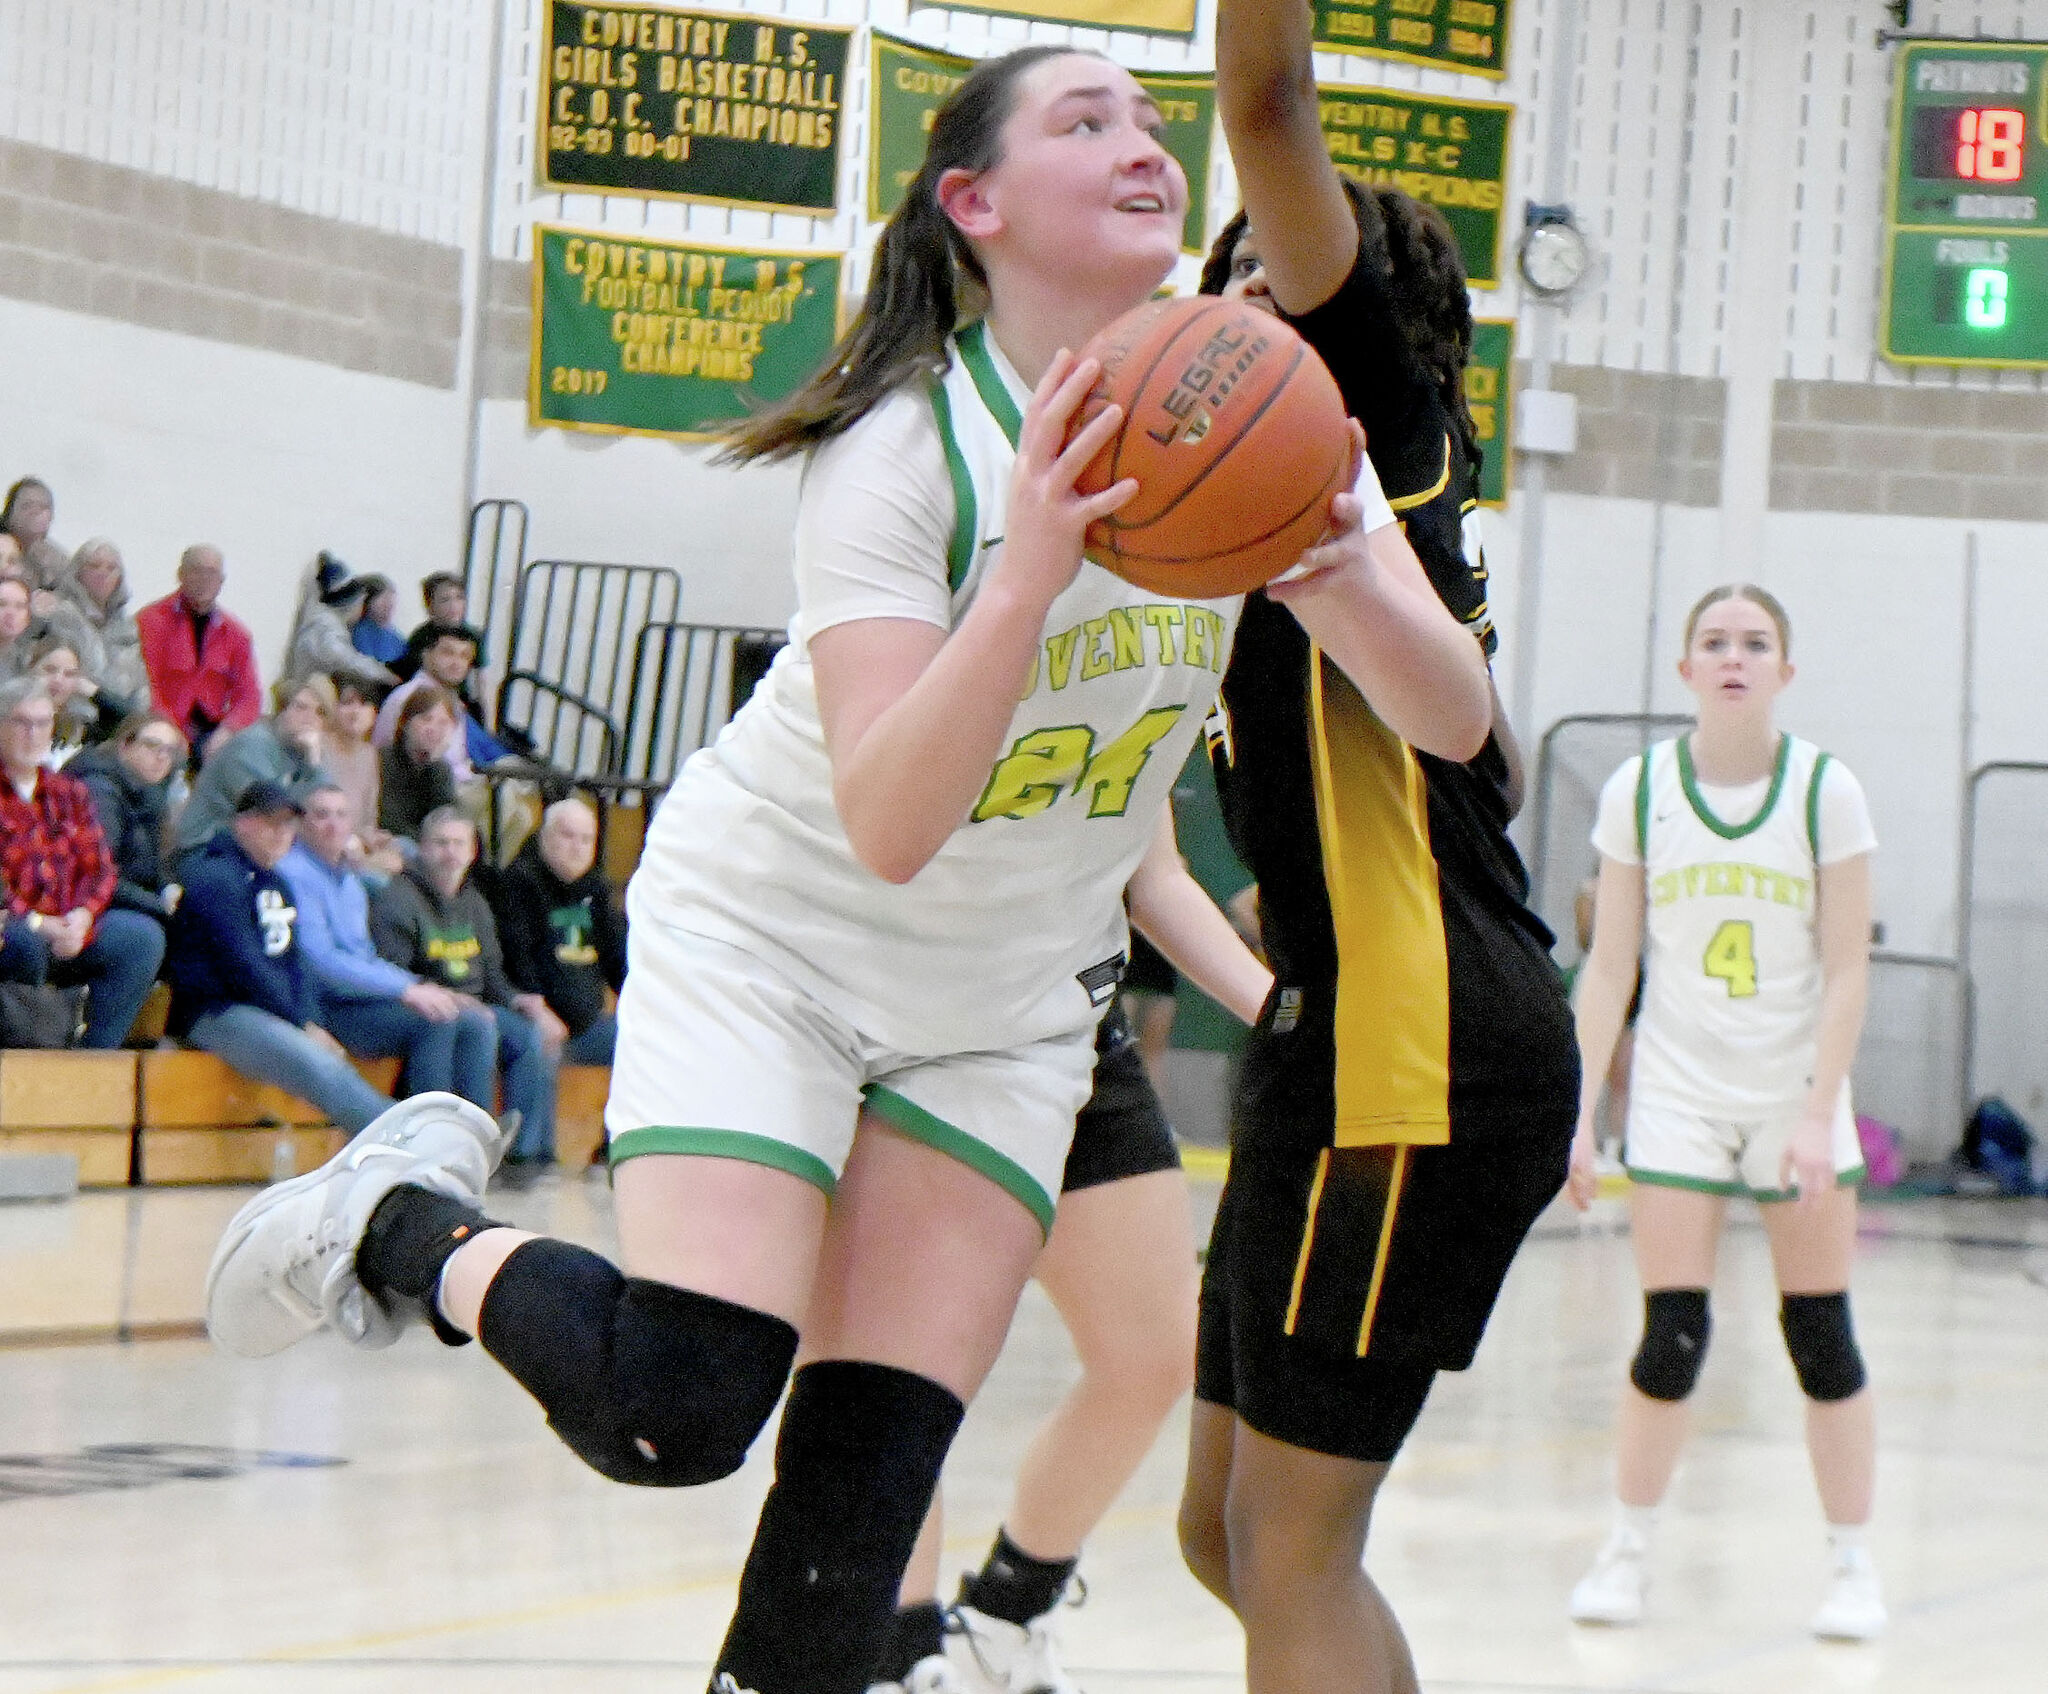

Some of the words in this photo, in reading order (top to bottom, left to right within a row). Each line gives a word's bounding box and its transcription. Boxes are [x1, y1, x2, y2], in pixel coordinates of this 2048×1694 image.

[582, 10, 729, 57] COVENTRY
[554, 46, 637, 88] GIRLS
[659, 56, 839, 110] BASKETBALL
[675, 97, 833, 149] CHAMPIONS
[1318, 102, 1411, 130] VENTRY
[625, 131, 691, 162] 00-01
[1325, 132, 1397, 161] RLS
[1956, 108, 2025, 181] 18
[565, 238, 726, 289] COVENTRY
[1937, 239, 2010, 266] FOULS
[582, 274, 699, 317] FOOTBALL
[1965, 268, 2009, 328] 0
[612, 311, 764, 352] CONFERENCE
[551, 367, 608, 394] 2017
[623, 343, 754, 381] CHAMPIONS
[1147, 314, 1250, 446] LEGAC
[1020, 604, 1225, 700] VENTRY
[969, 702, 1188, 823] 24
[1703, 919, 1758, 998] 4
